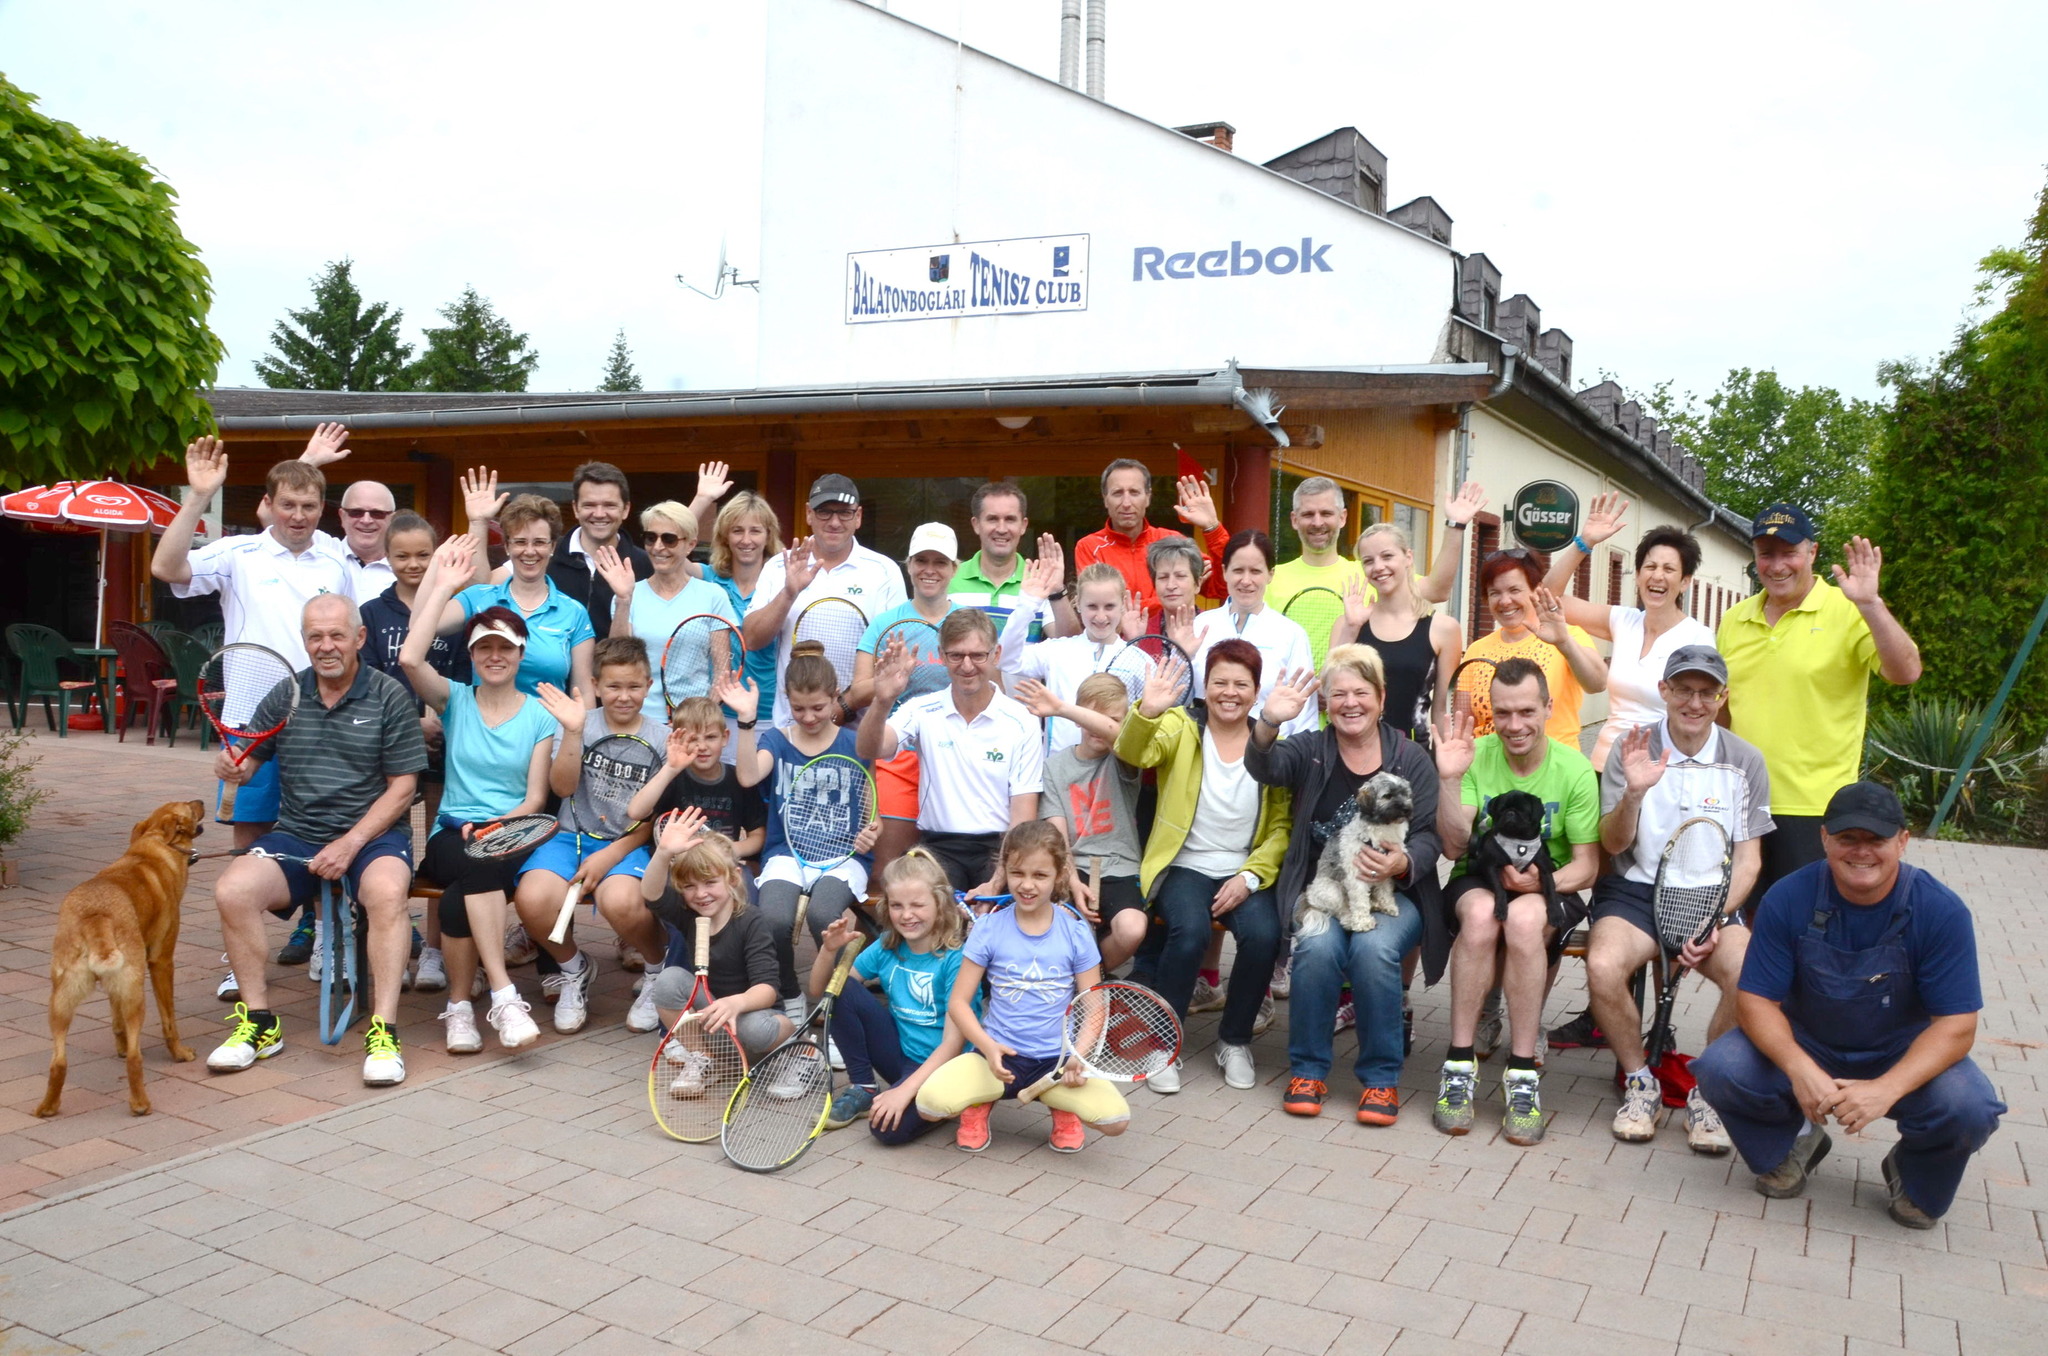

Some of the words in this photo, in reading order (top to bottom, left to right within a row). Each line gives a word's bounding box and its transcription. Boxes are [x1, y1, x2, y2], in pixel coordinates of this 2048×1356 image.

[1133, 237, 1334, 282] Reebok
[852, 260, 966, 315] BALATONBOGLÁRI
[970, 250, 1031, 308] TENISZ
[1035, 280, 1082, 305] CLUB
[93, 508, 124, 516] ALGIDA
[1518, 502, 1572, 527] Gösser
[613, 762, 633, 779] DO
